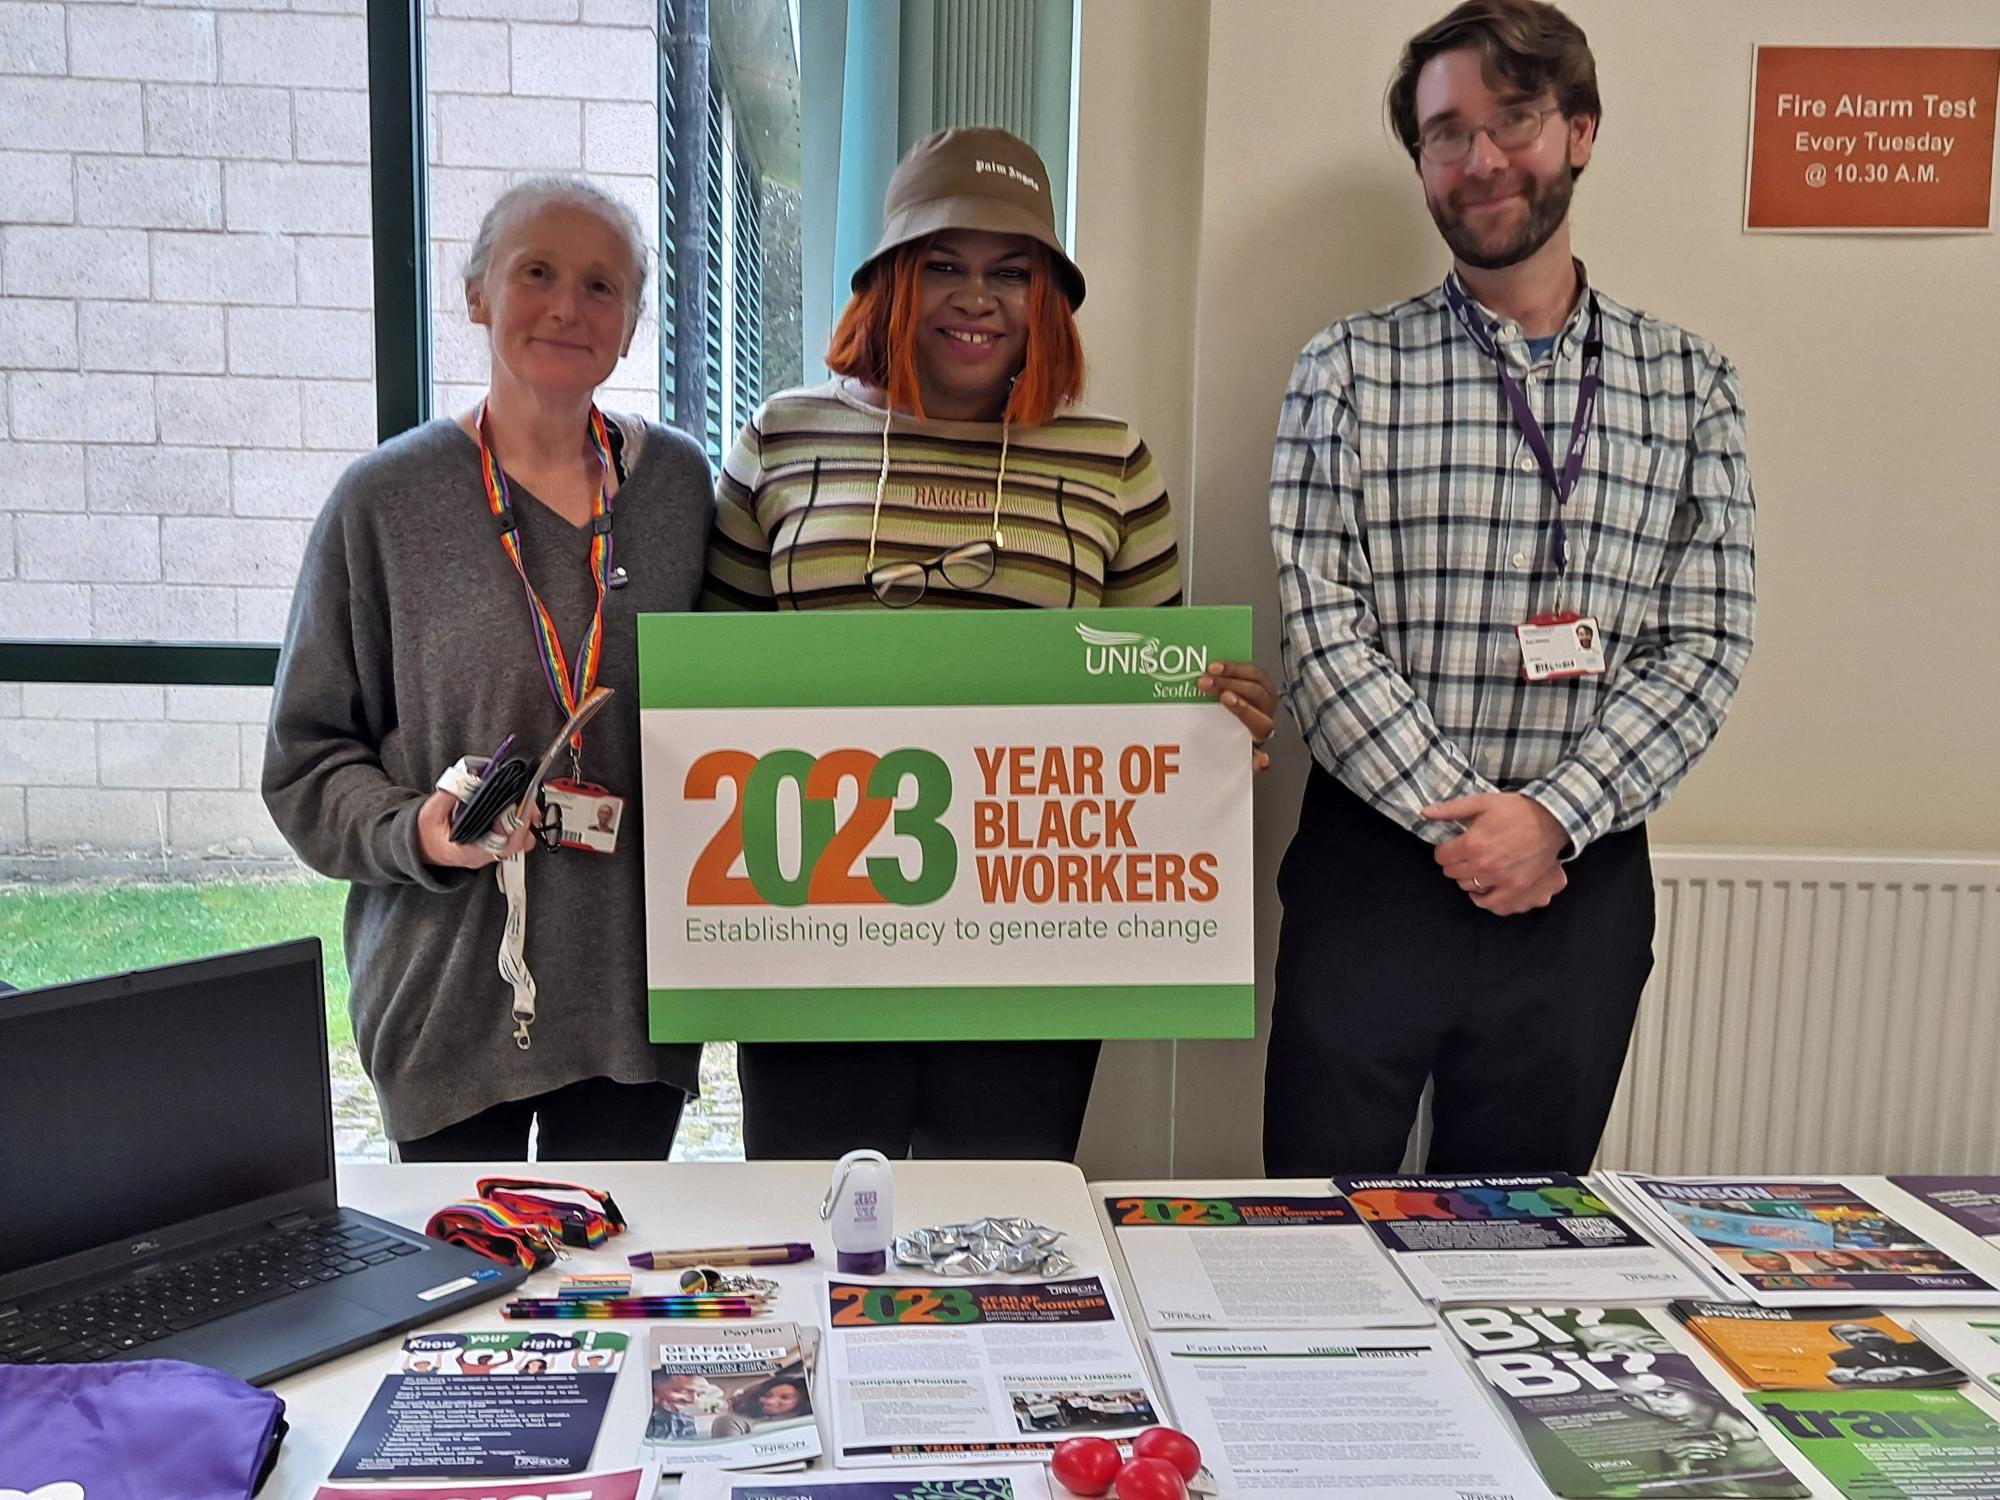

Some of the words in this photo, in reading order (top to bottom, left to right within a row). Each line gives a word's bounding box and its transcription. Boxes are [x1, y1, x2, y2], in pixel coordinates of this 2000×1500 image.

[1777, 93, 1827, 118] Fire
[1834, 93, 1913, 118] Alarm
[1922, 93, 1978, 119] Test
[1795, 131, 1857, 156] Every
[1863, 131, 1955, 157] Tuesday
[1804, 163, 1827, 188] @
[1834, 163, 1889, 183] 10.30
[1894, 163, 1940, 183] A.M.
[1085, 644, 1208, 676] UNISON
[973, 745, 1104, 796] YEAR
[1118, 744, 1181, 795] OF
[683, 745, 959, 909] 2023
[974, 799, 1138, 850] BLACK
[974, 852, 1220, 905] WORKERS
[685, 916, 849, 946] Establishing
[858, 916, 946, 946] legacy
[955, 918, 980, 941] to
[989, 916, 1108, 945] generate
[1117, 913, 1219, 944] change
[1484, 1176, 1554, 1187] Workers
[1115, 1199, 1241, 1225] 2023
[830, 1287, 980, 1327] 2023
[408, 1339, 457, 1350] Know
[470, 1334, 511, 1345] your
[521, 1338, 573, 1350] rights
[722, 1326, 784, 1339] PayPlan
[1443, 1306, 1615, 1351] Bi?
[714, 1349, 782, 1362] ADVICE
[1478, 1350, 1666, 1398] Bi?
[1761, 1402, 1966, 1440] tran
